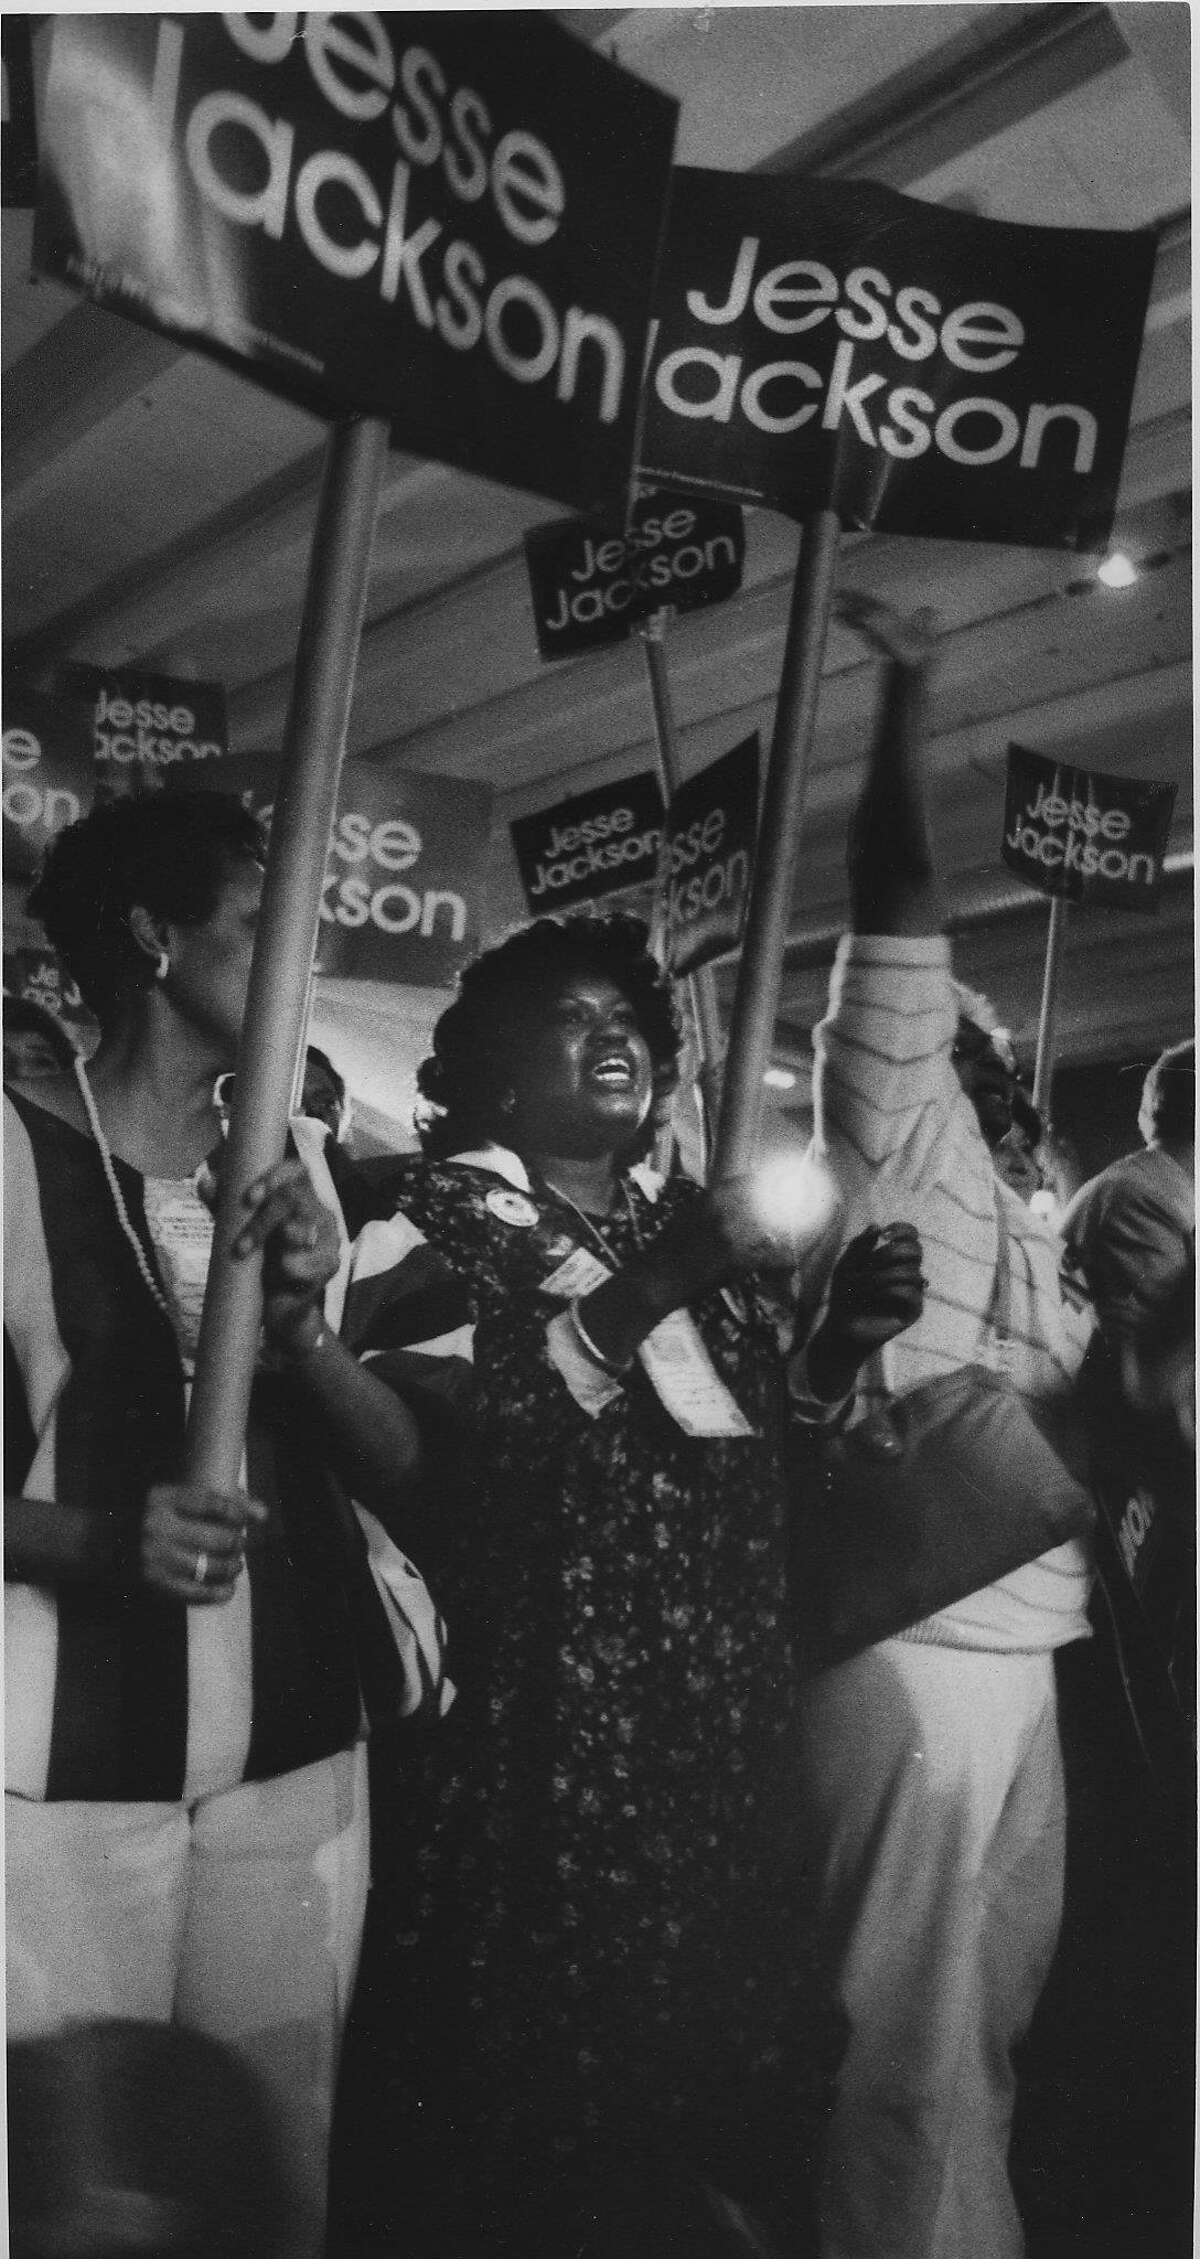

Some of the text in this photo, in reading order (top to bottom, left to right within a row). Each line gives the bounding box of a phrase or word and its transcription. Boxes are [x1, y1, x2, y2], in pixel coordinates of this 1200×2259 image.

[687, 237, 1025, 373] Jesse
[638, 319, 1098, 473] ackson
[545, 808, 634, 858] Jesse
[1027, 783, 1131, 840] Jesse
[531, 829, 661, 894] Jackson
[1007, 814, 1155, 885] Jackson
